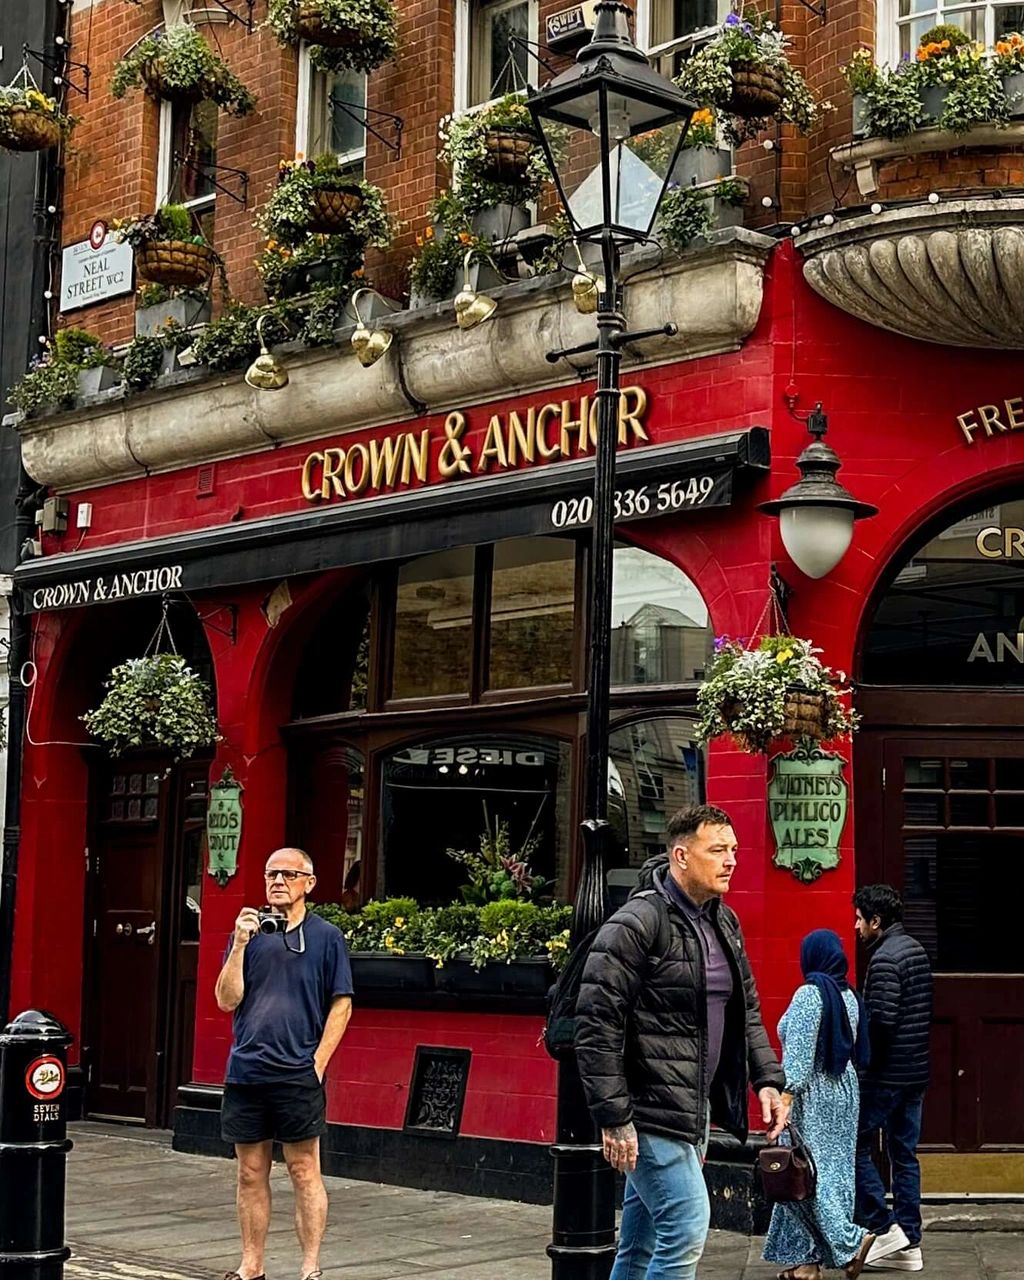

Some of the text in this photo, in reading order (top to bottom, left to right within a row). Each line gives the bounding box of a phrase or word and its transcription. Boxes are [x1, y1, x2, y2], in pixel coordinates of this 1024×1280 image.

[83, 257, 110, 278] NEAL
[67, 274, 104, 299] STREET
[106, 271, 124, 286] WC2
[302, 428, 430, 502] CROWN
[438, 411, 472, 477] &
[551, 496, 593, 527] 020
[657, 476, 714, 511] 5649
[33, 565, 183, 609] CROWN & ANCHOR
[773, 802, 841, 822] PIMLICO
[781, 828, 829, 847] ALES
[33, 1104, 60, 1113] SEVEN
[33, 1113, 59, 1122] DIALS
